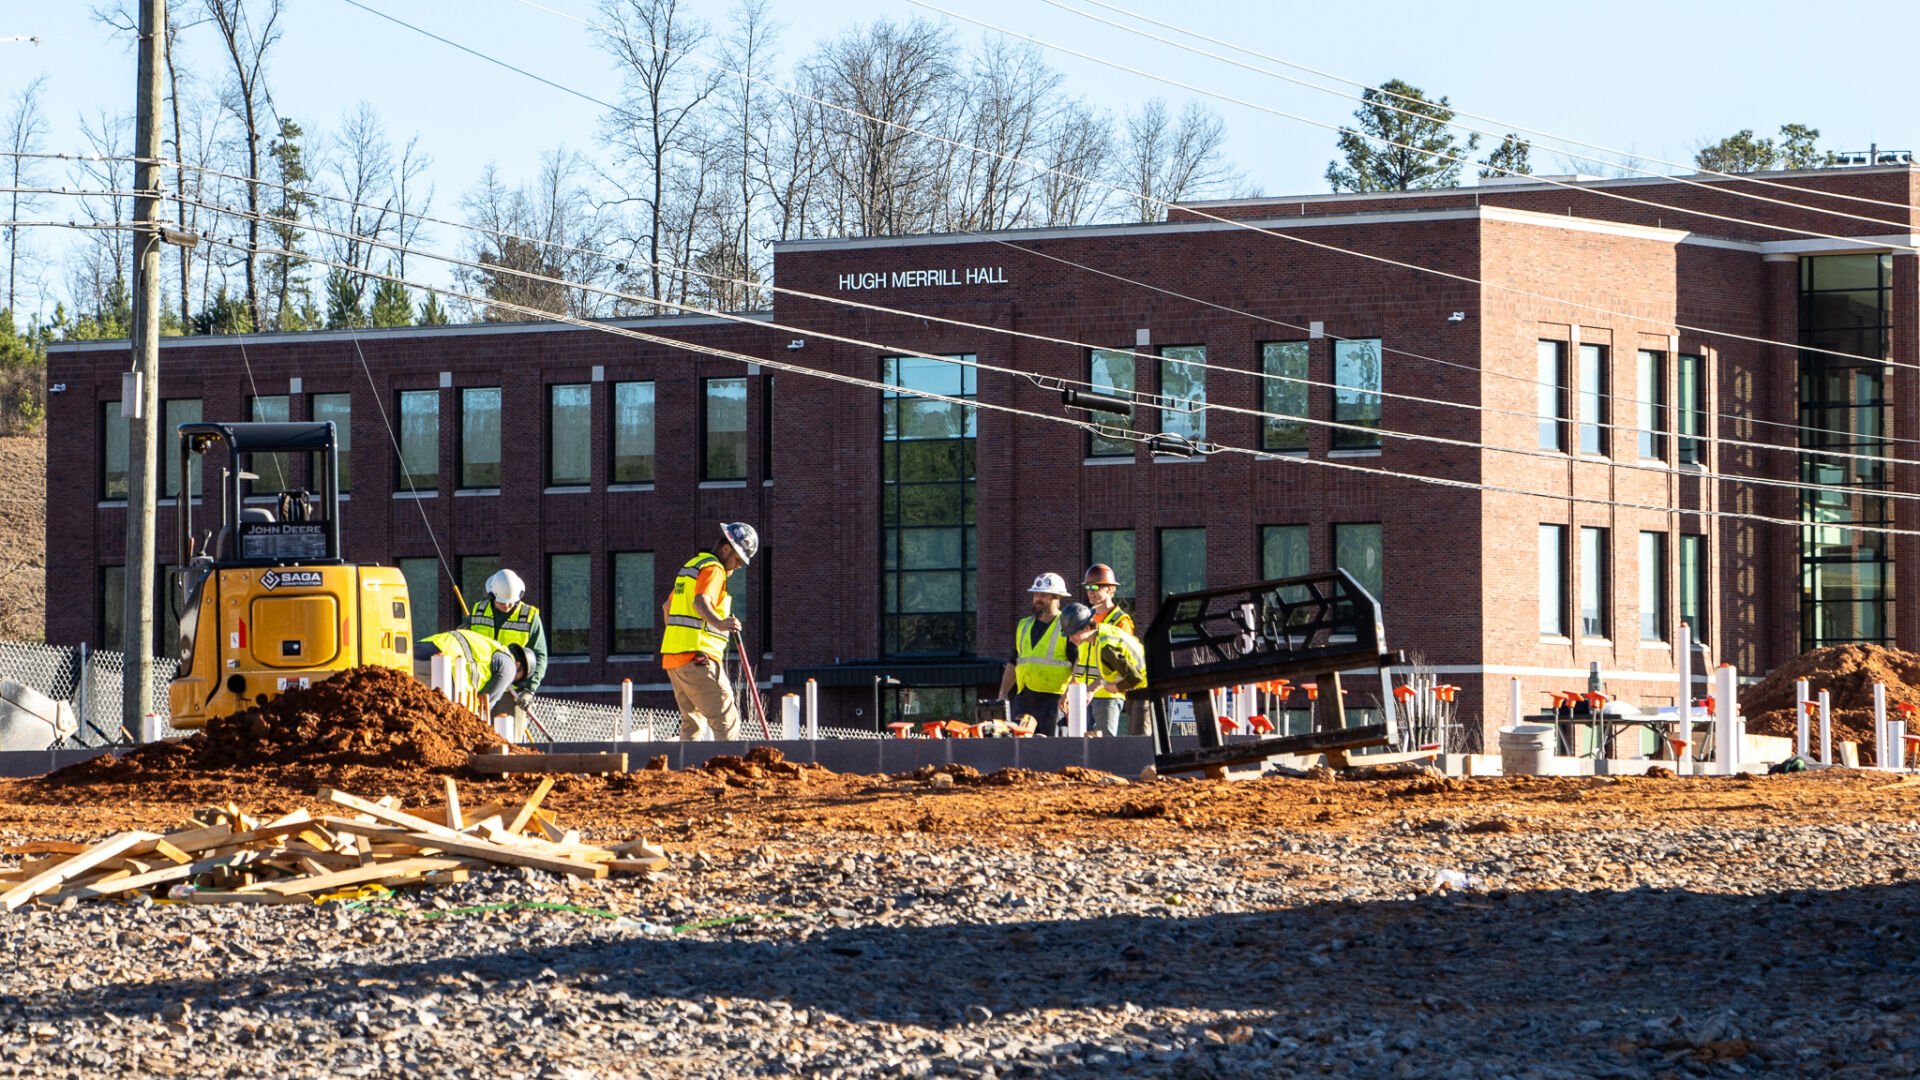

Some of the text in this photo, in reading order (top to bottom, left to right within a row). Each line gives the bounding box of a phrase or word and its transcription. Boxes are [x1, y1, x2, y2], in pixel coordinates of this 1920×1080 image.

[839, 266, 1008, 290] HUGH MERRILL HALL
[281, 572, 321, 582] SAGA
